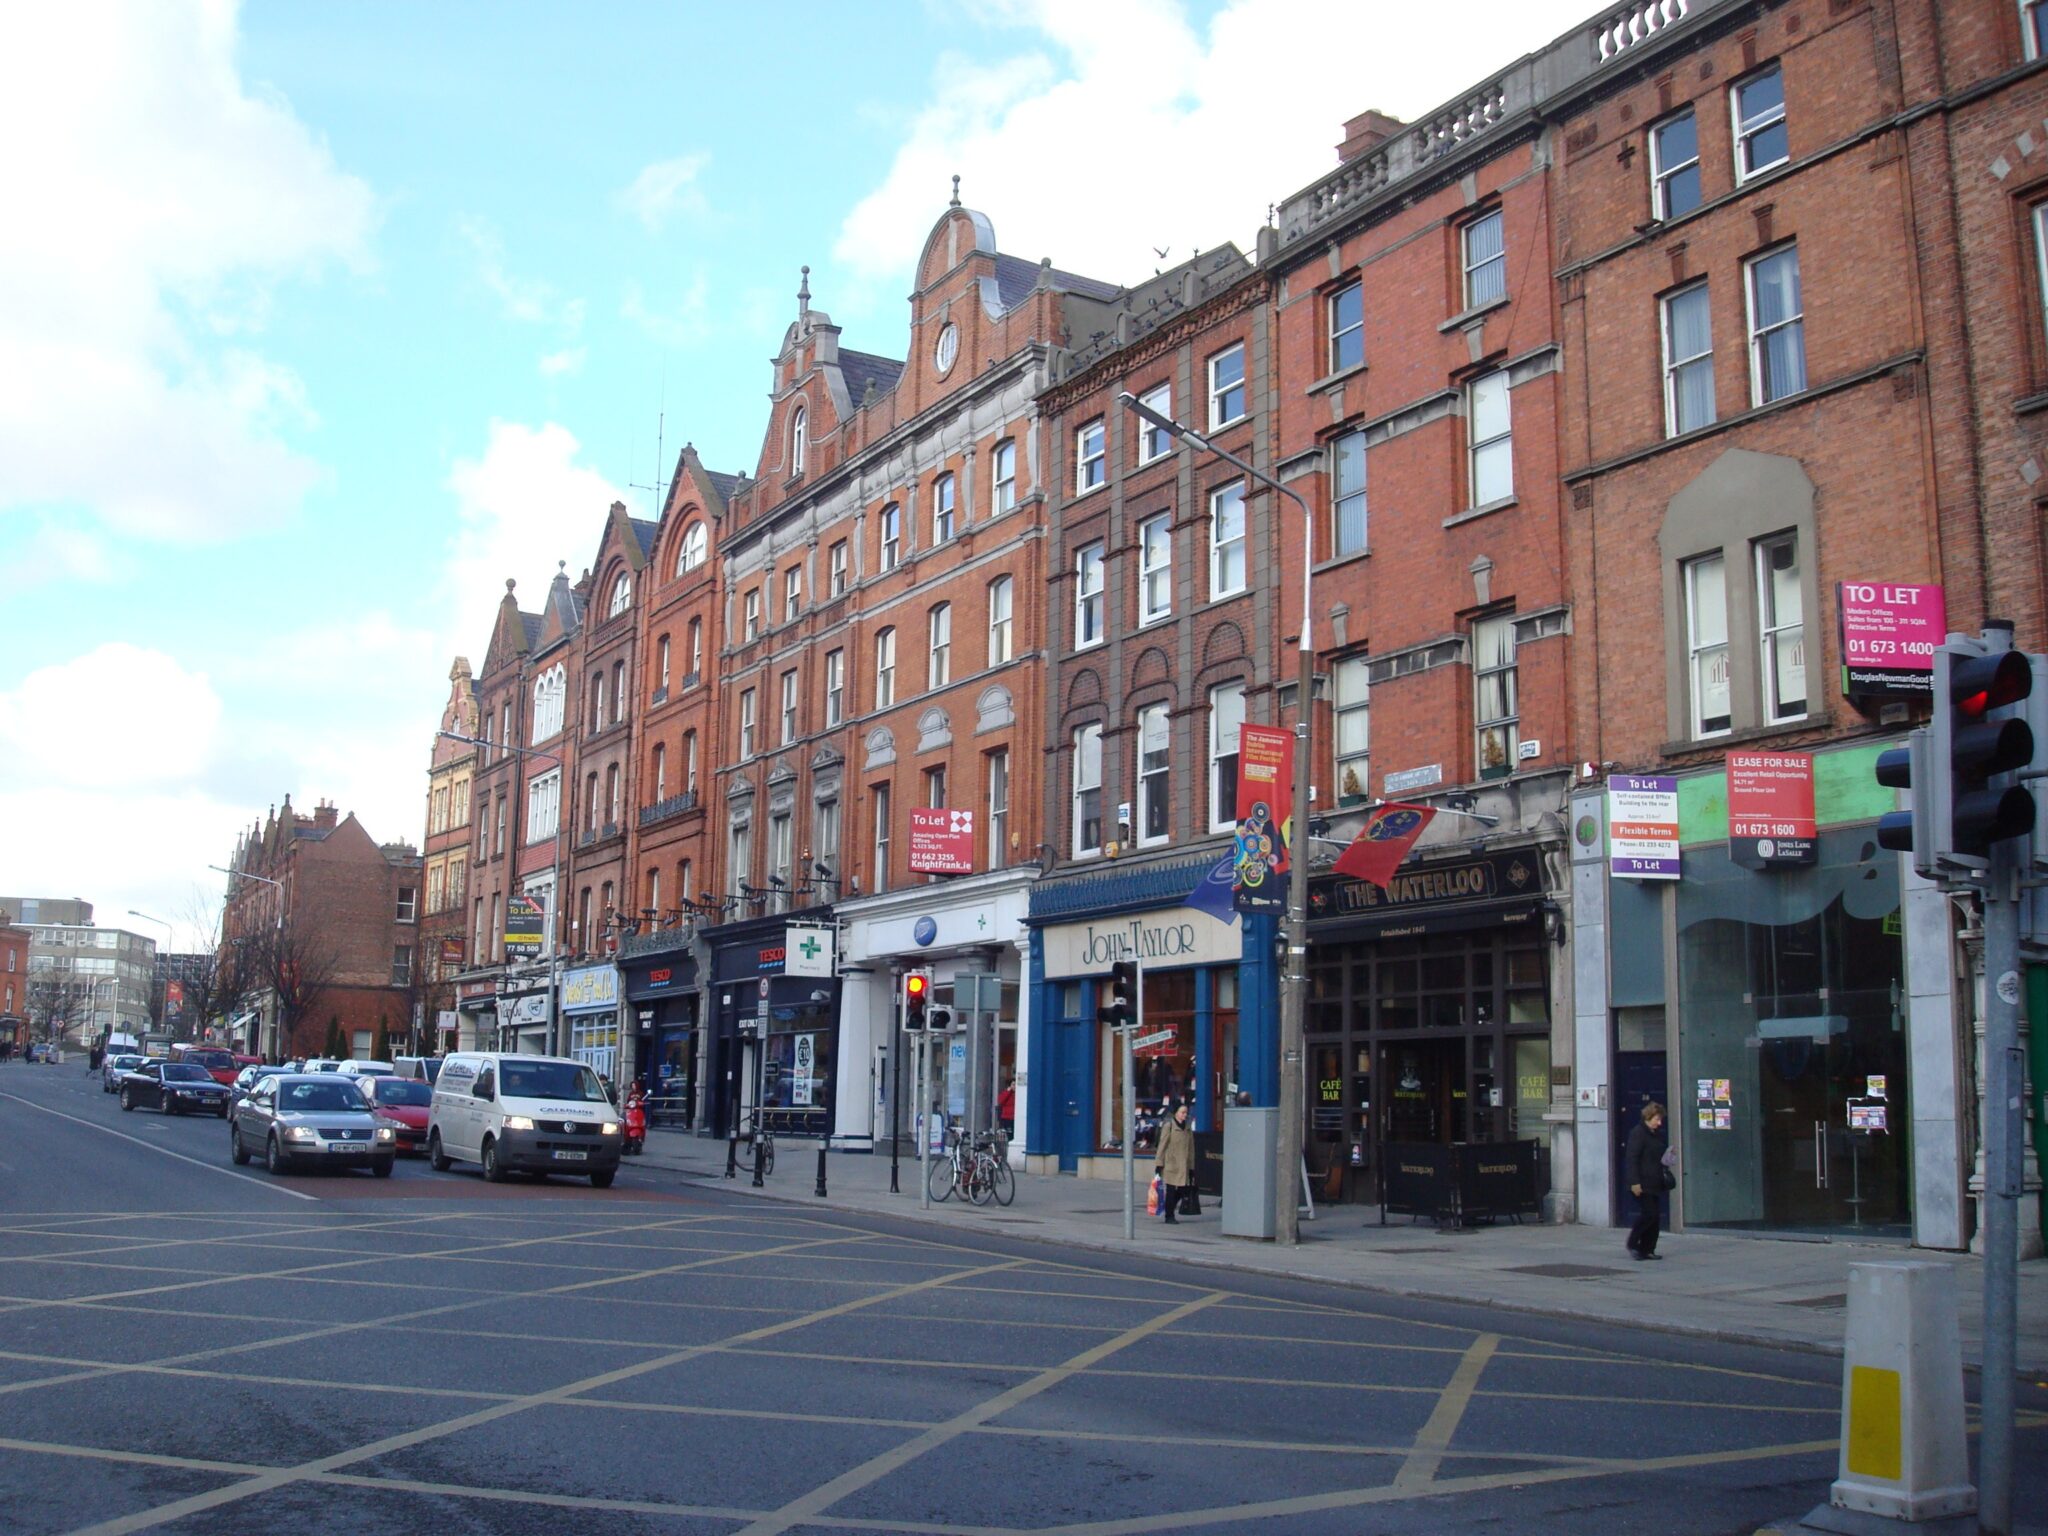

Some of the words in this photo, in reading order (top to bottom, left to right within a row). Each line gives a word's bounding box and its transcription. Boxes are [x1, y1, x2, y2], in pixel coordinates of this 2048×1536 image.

[1845, 585, 1876, 603] TO
[1883, 587, 1920, 605] LET
[1848, 623, 1877, 631] Attractive
[1878, 624, 1897, 632] Terms
[1849, 639, 1866, 653] 01
[1870, 640, 1896, 654] 673
[1900, 642, 1934, 655] 1400
[1850, 671, 1929, 683] DouglasNewmanGood
[1732, 757, 1762, 767] LEASE
[1763, 758, 1782, 767] FOR
[1783, 758, 1808, 768] SALE
[1775, 772, 1808, 780] Opportunity
[1629, 779, 1640, 789] To
[1642, 779, 1658, 789] Let
[912, 814, 926, 825] To
[928, 815, 945, 826] Let
[1619, 827, 1649, 836] Flexible
[1649, 827, 1673, 836] Terms
[1735, 823, 1747, 835] 01
[1750, 824, 1769, 835] 673
[1771, 824, 1795, 836] 1600
[912, 832, 934, 840] Amazing
[921, 853, 936, 861] 662
[911, 860, 972, 870] KnightFrank.ie
[1631, 860, 1641, 869] To
[1644, 860, 1660, 870] Let
[1344, 883, 1378, 908] THE
[1383, 867, 1485, 903] WATERLOO
[509, 905, 519, 915] To
[520, 906, 534, 915] Let
[1380, 926, 1411, 938] Established
[1082, 926, 1128, 965] JOHN
[1129, 919, 1196, 959] TAYLOR
[506, 944, 516, 952] 77
[759, 947, 785, 962] TESCO
[650, 968, 672, 982] TESCO
[747, 1019, 758, 1028] ONLY
[1320, 1078, 1342, 1090] CAFÉ
[1519, 1074, 1547, 1087] CAFÉ
[1322, 1090, 1340, 1101] BAR
[1522, 1087, 1544, 1099] BAR
